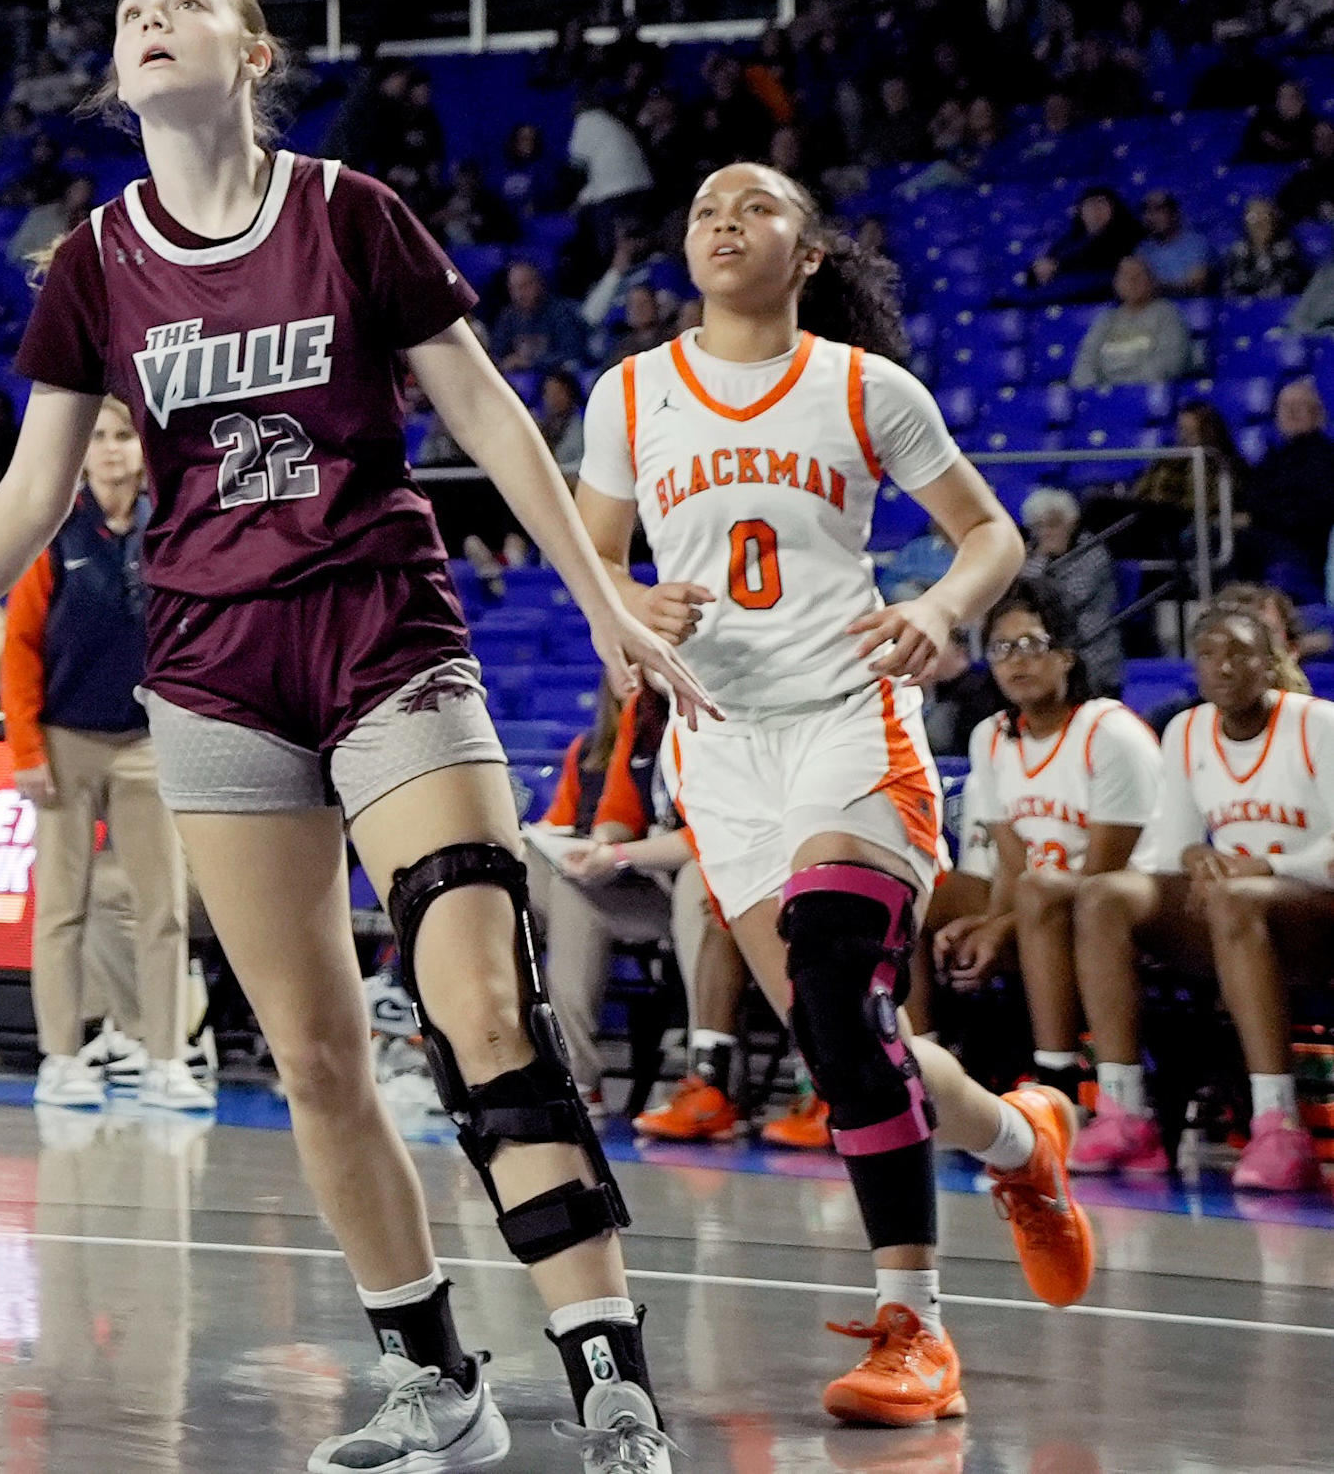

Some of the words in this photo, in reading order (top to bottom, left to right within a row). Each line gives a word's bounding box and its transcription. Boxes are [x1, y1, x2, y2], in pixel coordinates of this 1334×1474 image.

[133, 315, 335, 430] VILLE
[145, 318, 203, 352] THE
[210, 412, 320, 509] 22
[656, 447, 847, 520] BLACKMAN
[727, 519, 784, 610] 0
